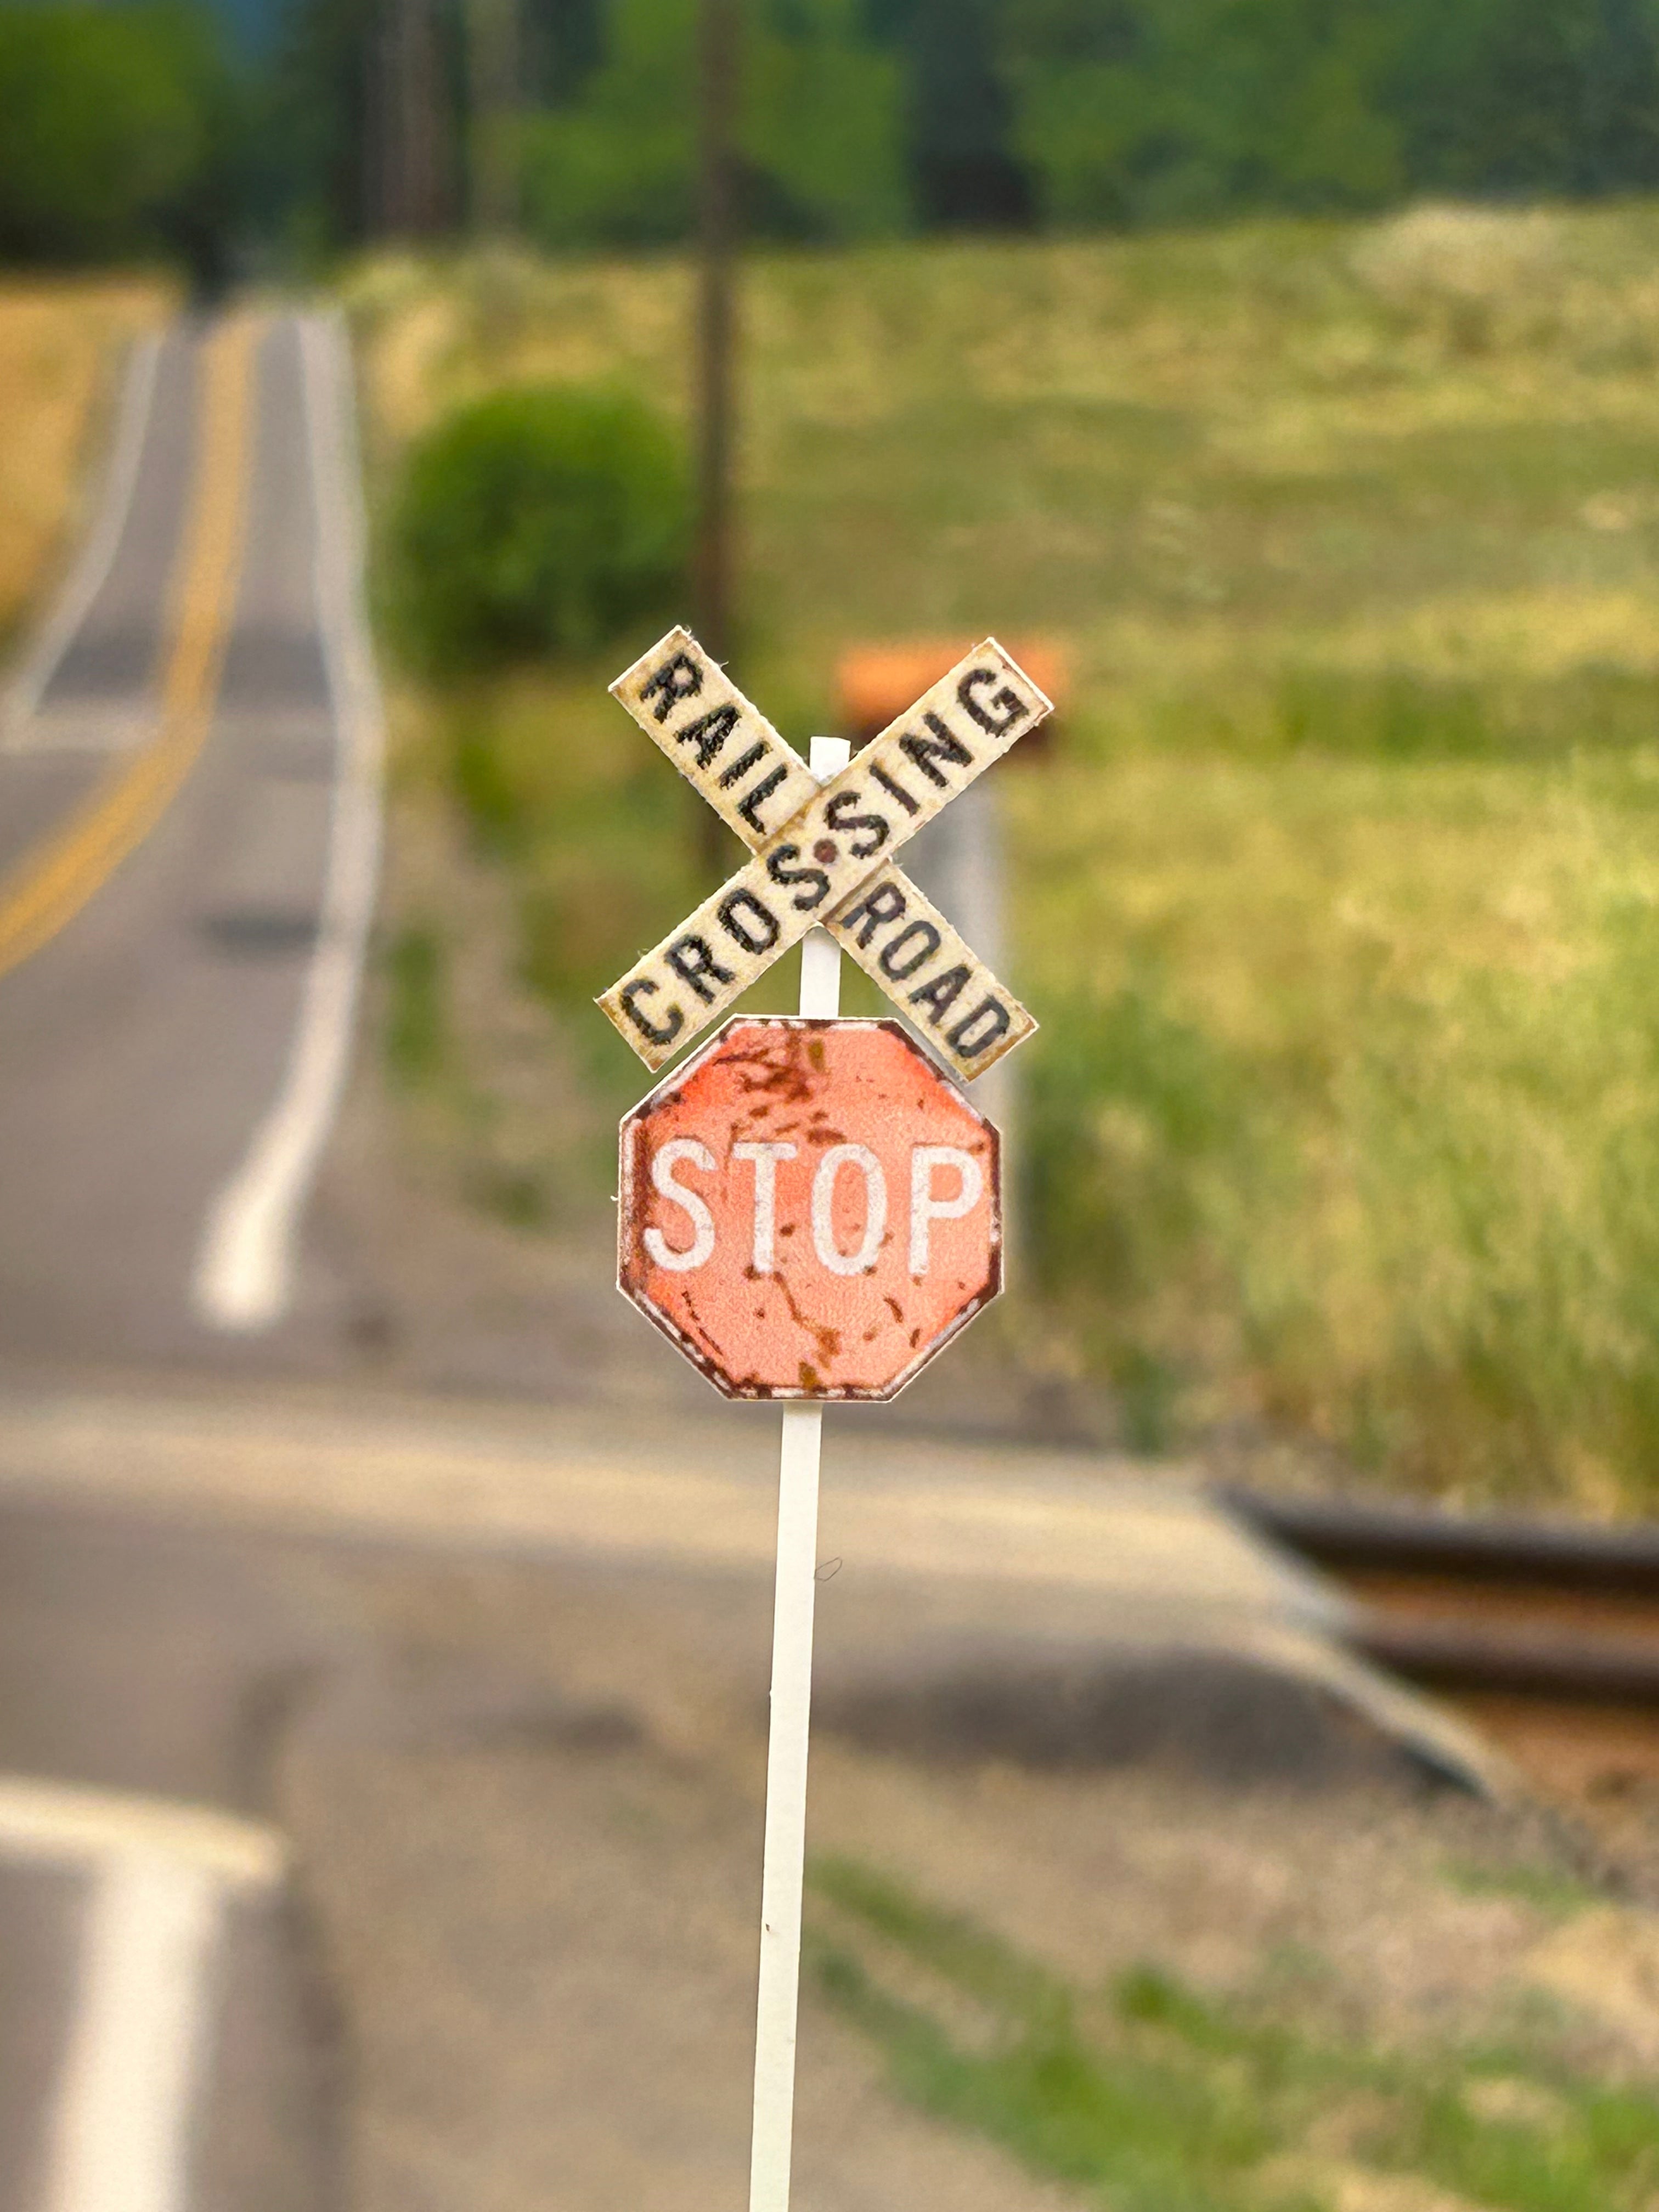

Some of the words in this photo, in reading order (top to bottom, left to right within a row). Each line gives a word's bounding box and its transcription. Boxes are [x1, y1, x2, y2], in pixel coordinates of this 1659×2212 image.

[618, 668, 1029, 1046] CROSSING
[640, 651, 788, 835] RAIL
[843, 881, 1011, 1059] ROAD
[642, 1138, 983, 1276] STOP
